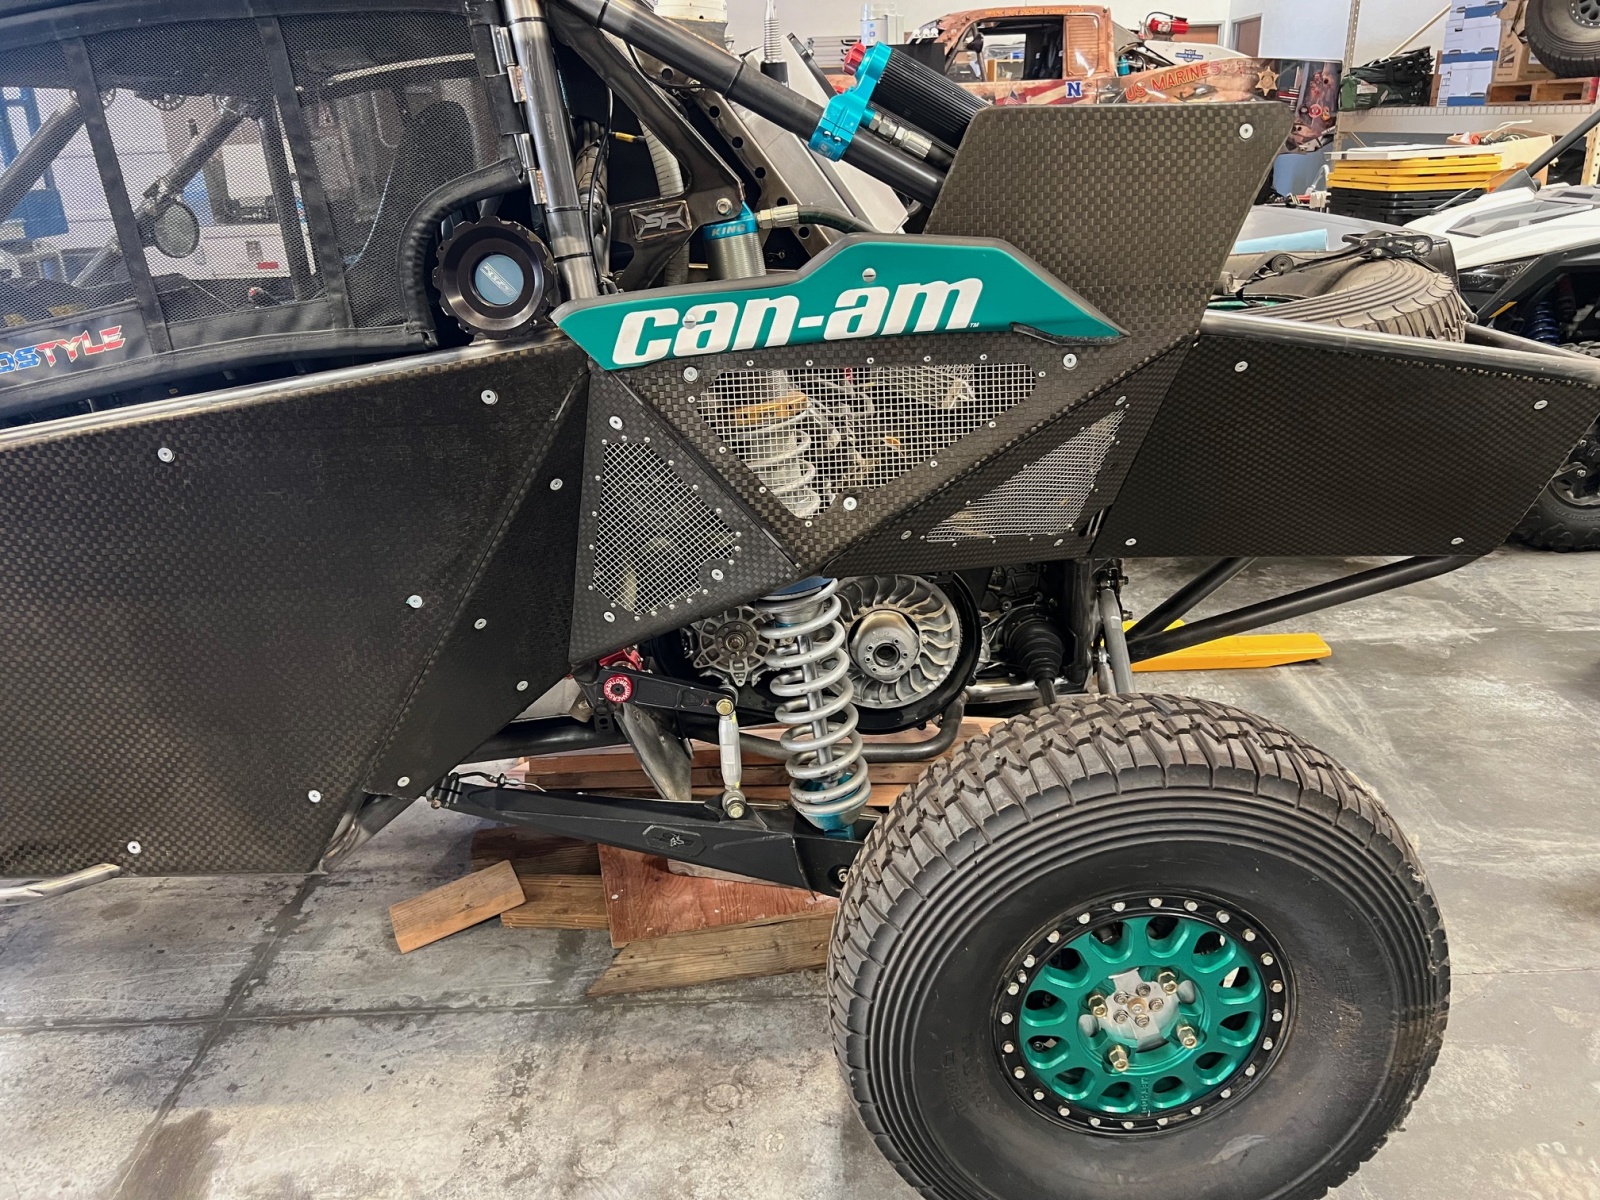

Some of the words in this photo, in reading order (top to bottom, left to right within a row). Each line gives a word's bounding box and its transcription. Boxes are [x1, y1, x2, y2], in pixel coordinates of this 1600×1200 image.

[1066, 81, 1082, 98] N
[1125, 82, 1147, 101] US
[1151, 61, 1221, 91] MARINES
[712, 223, 746, 237] KING
[612, 278, 983, 364] can-am
